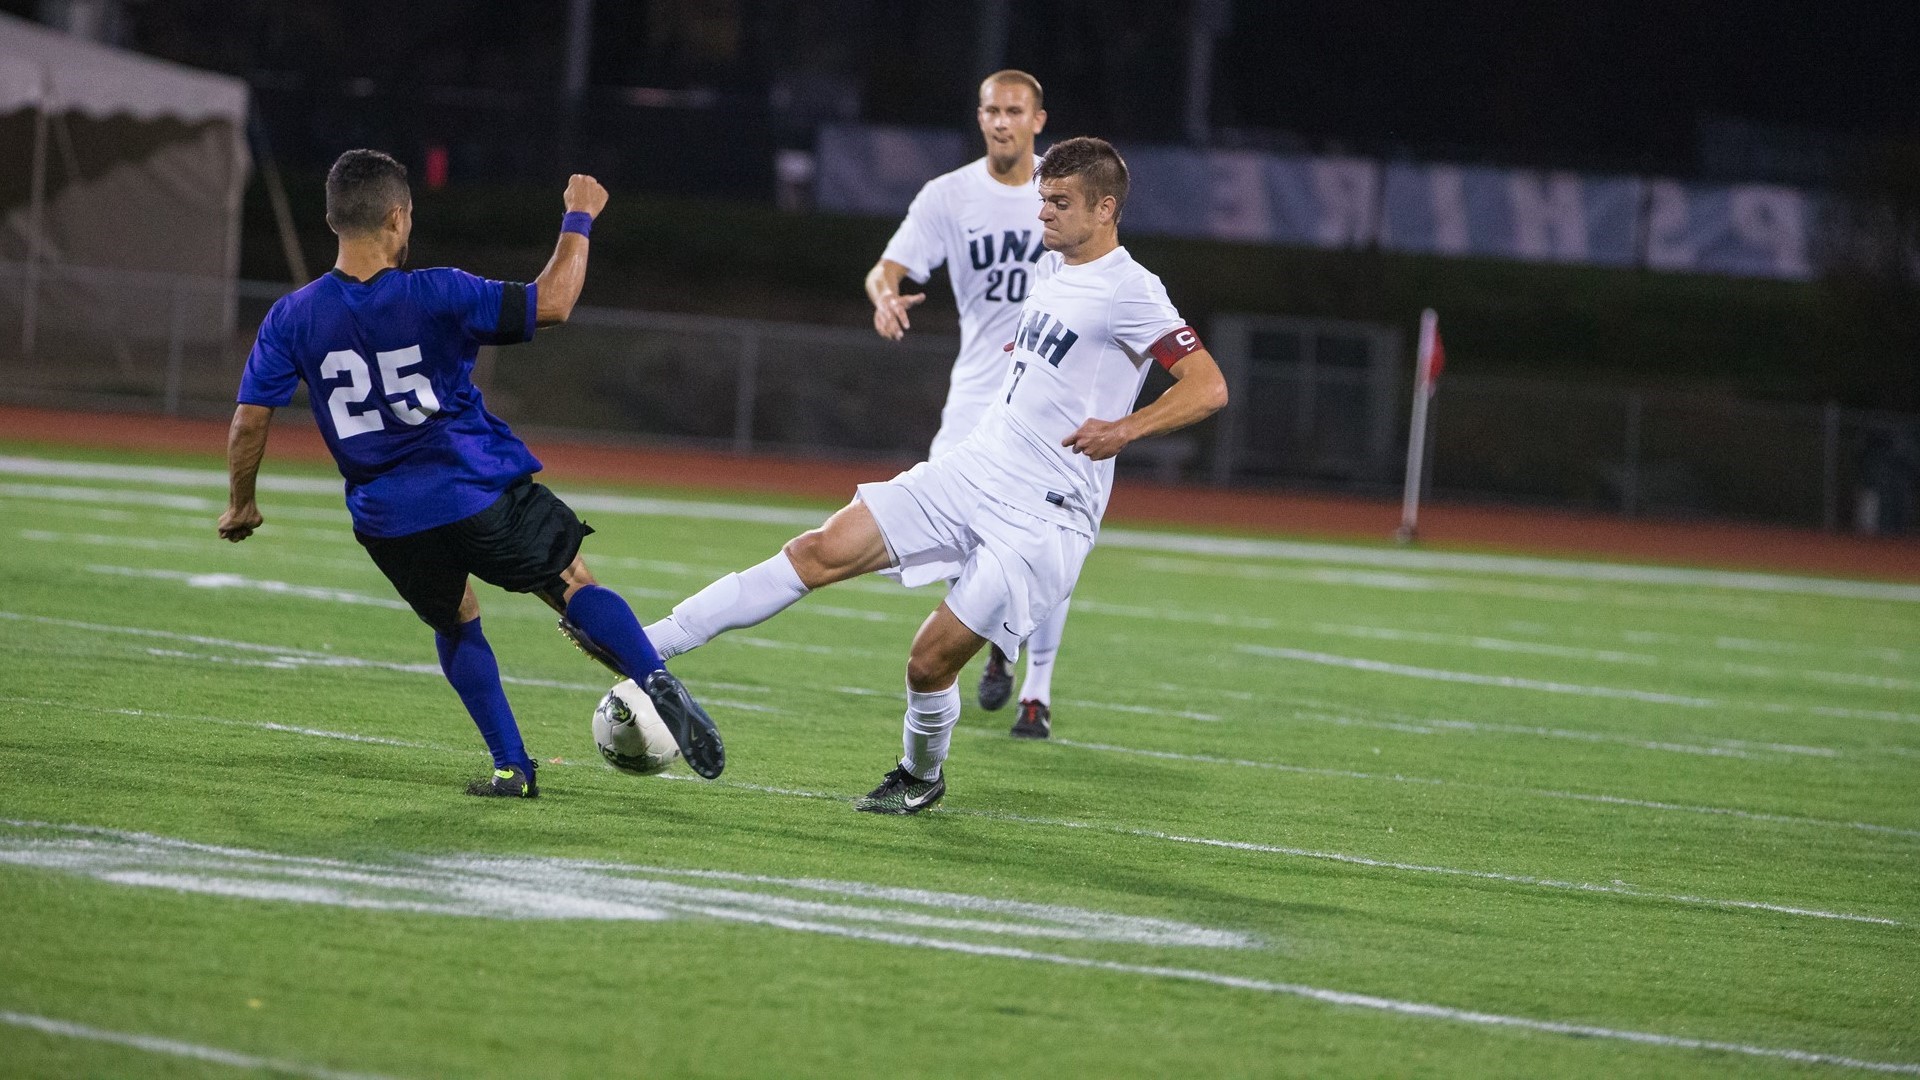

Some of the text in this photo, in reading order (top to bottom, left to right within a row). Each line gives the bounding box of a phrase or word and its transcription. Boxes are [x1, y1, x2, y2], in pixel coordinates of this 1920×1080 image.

[986, 269, 1027, 303] 20
[1014, 310, 1079, 368] NH
[1176, 331, 1196, 346] C
[320, 344, 440, 440] 25
[1006, 361, 1027, 404] 7
